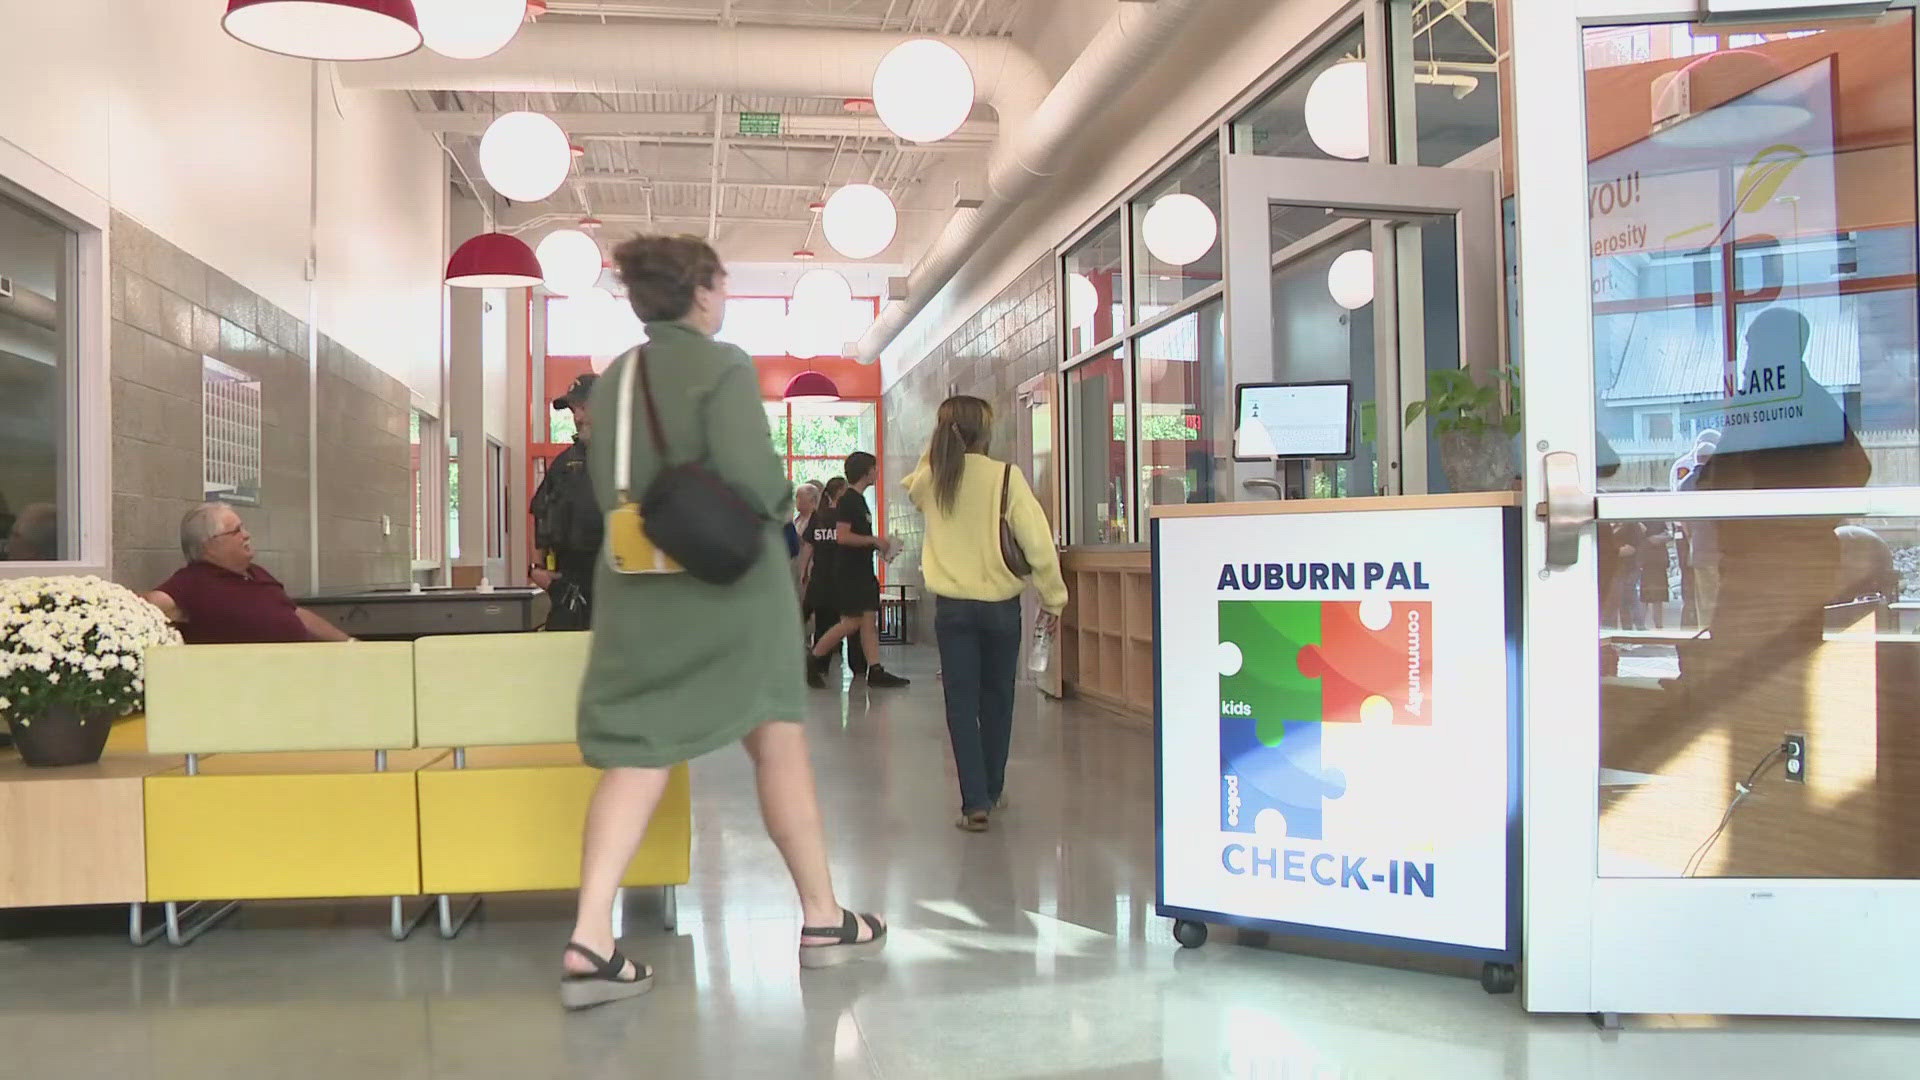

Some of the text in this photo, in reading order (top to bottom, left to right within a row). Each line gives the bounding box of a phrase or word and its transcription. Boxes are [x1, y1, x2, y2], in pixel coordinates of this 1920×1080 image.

[1753, 405, 1803, 424] SOLUTION
[1217, 561, 1430, 590] AUBURN PAL
[1405, 610, 1424, 717] community
[1221, 700, 1252, 716] kids
[1224, 774, 1242, 827] police
[1221, 842, 1435, 898] CHECK-IN
